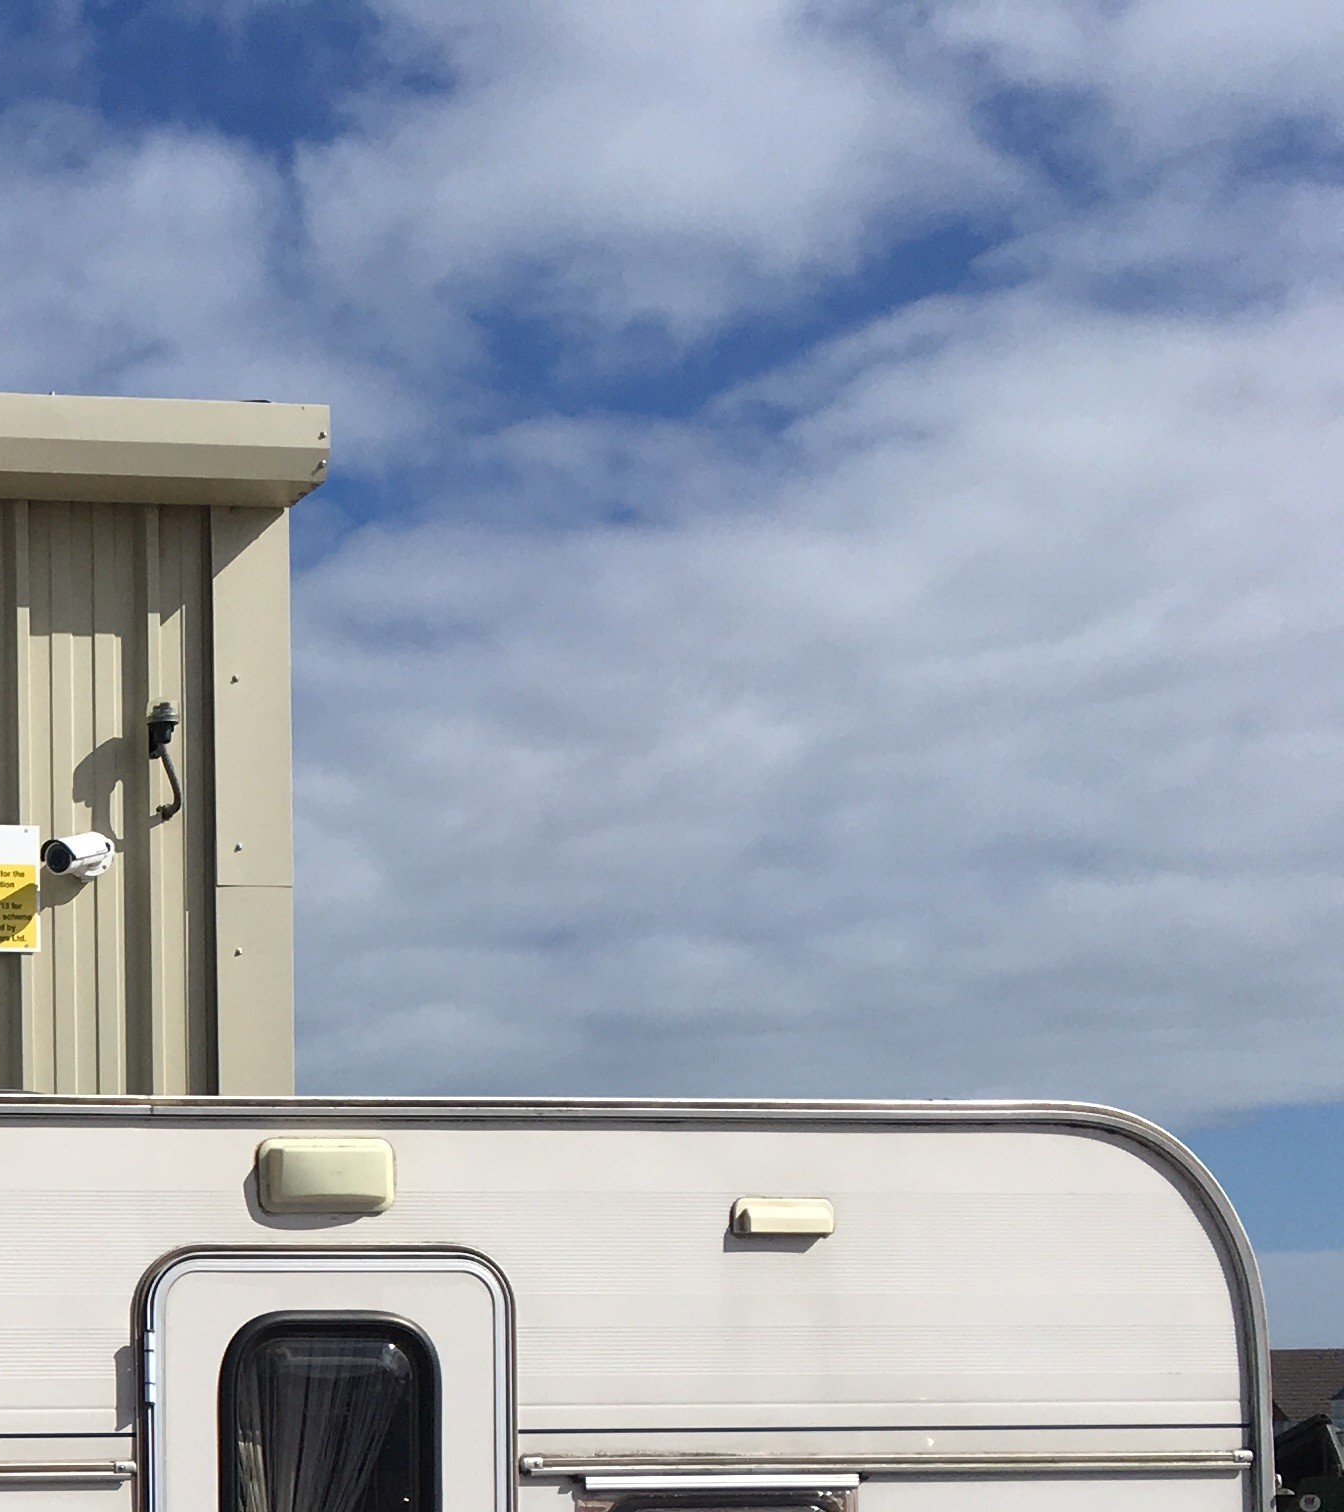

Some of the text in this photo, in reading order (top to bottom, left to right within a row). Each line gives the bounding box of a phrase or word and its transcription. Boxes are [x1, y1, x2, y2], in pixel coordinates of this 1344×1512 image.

[0, 870, 11, 878] for
[12, 870, 25, 878] the
[6, 924, 16, 933] by
[12, 934, 26, 942] Ltd.
